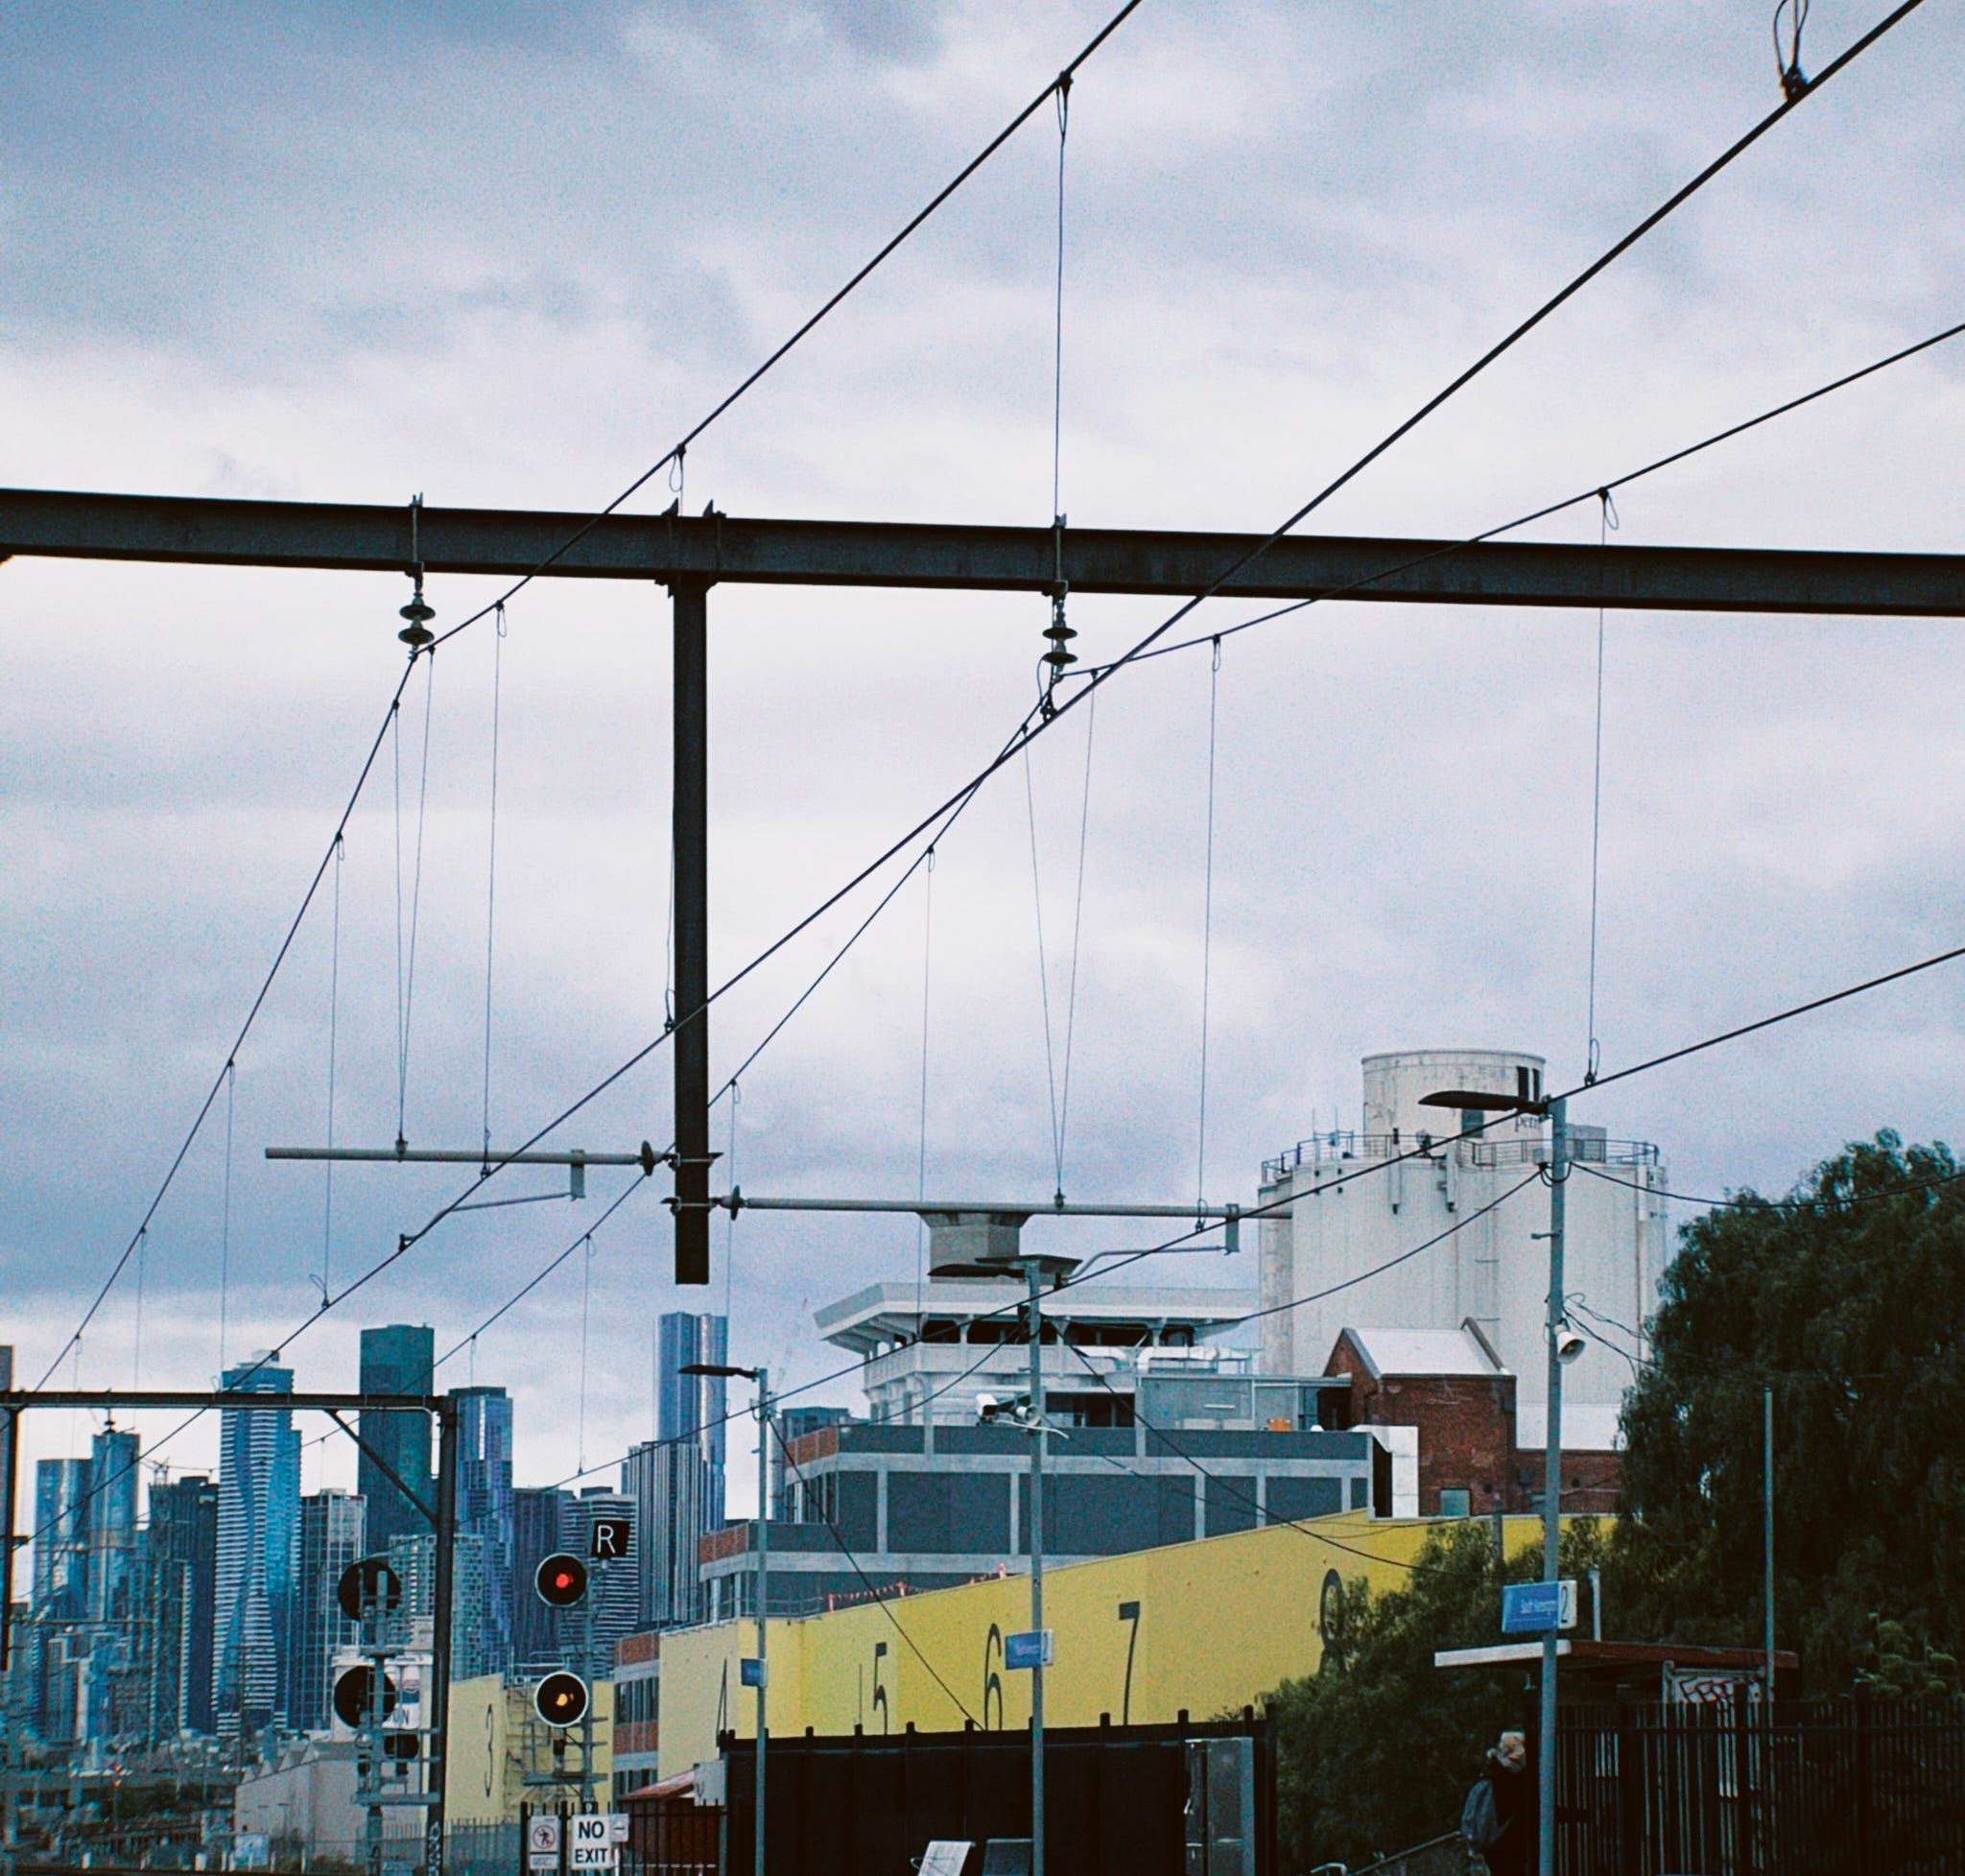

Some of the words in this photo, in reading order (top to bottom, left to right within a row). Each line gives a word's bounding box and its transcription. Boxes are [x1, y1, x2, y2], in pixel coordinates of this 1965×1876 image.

[597, 1524, 617, 1554] R
[1560, 1585, 1570, 1624] 2
[872, 1640, 888, 1736] 5
[983, 1622, 1003, 1731] 6
[1118, 1600, 1141, 1726] 7
[484, 1702, 495, 1798] 3
[575, 1847, 608, 1864] EXIT
[578, 1820, 605, 1840] NO
